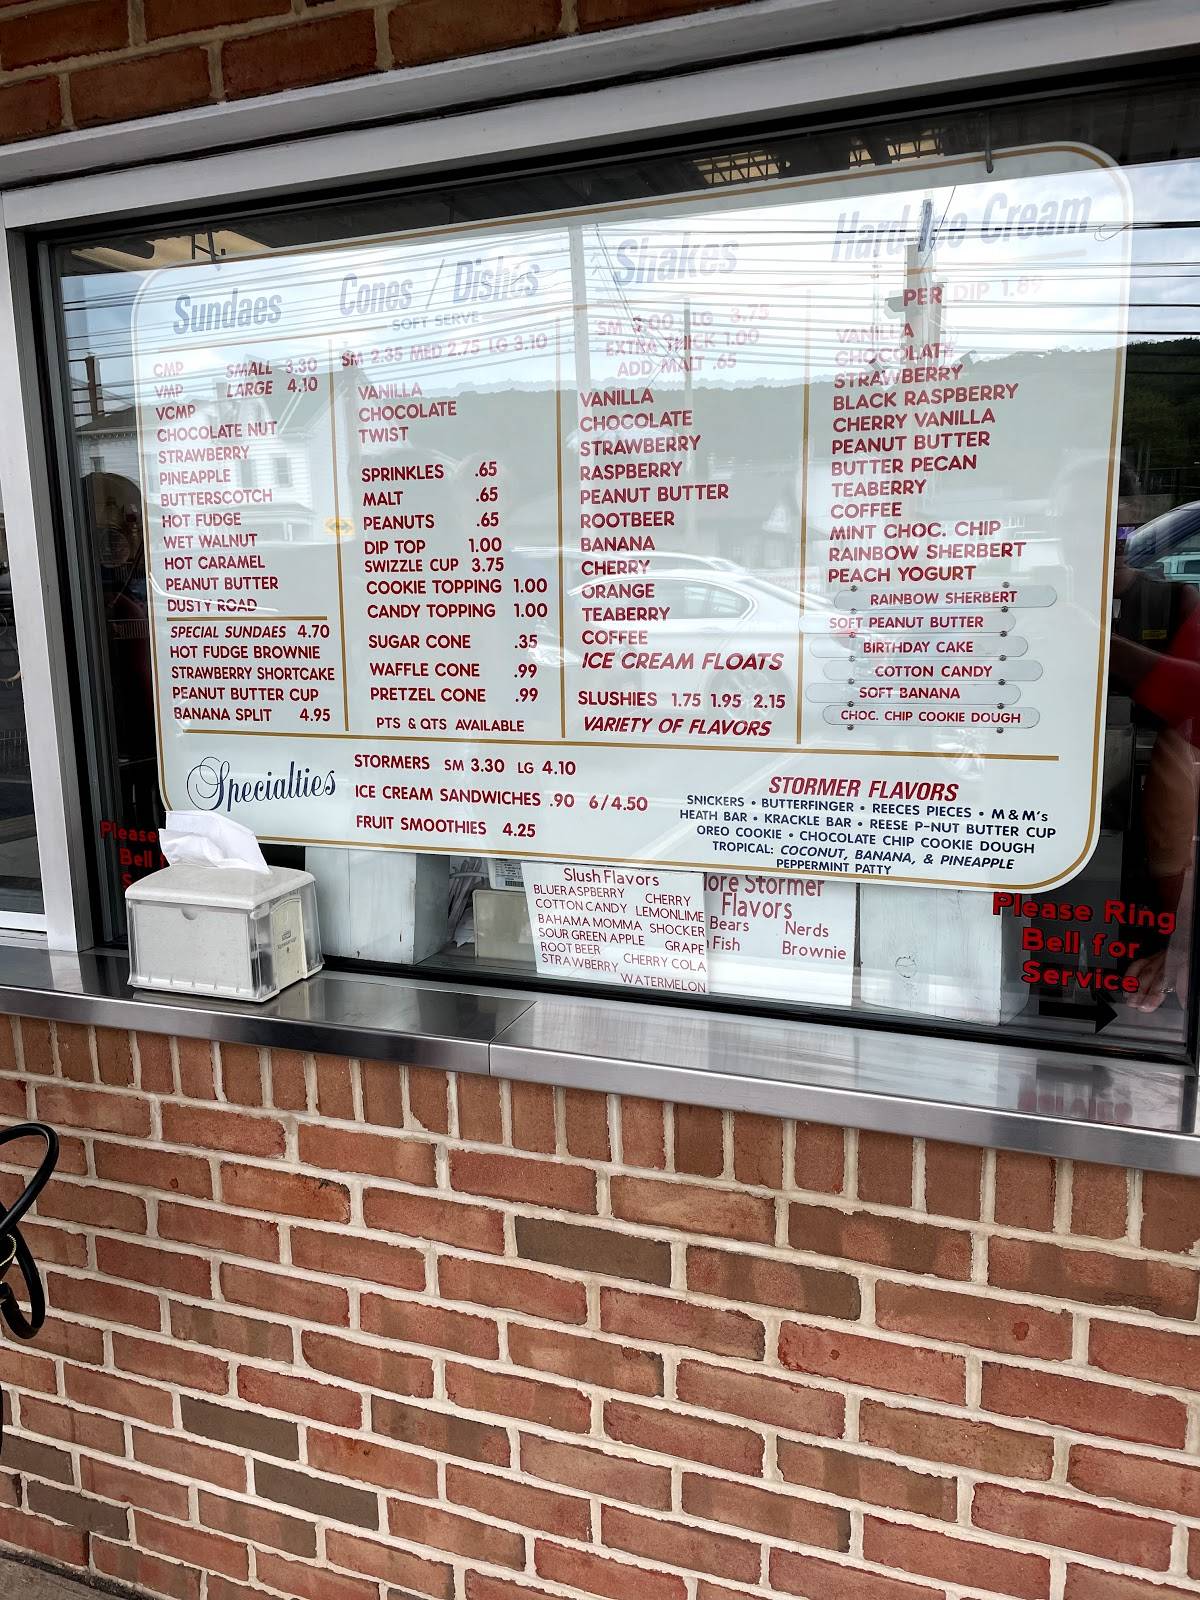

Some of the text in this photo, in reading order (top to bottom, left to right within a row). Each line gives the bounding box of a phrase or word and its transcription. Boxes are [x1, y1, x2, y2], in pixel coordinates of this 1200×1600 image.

[832, 193, 1091, 262] Hard Cream
[615, 237, 739, 285] Shakes
[340, 273, 413, 316] Cones
[173, 288, 282, 334] Sundaes
[392, 311, 480, 331] SOFT SERVE
[836, 322, 914, 344] VANILLA
[153, 361, 184, 377] CMP
[834, 364, 963, 389] STRAWBERRY
[227, 377, 318, 397] LARGE 4.10
[358, 382, 422, 399] VANILLA
[580, 388, 654, 407] VANILLA
[156, 405, 196, 420] VCMP
[833, 408, 995, 432] CHERRY VANILLA
[358, 426, 408, 443] TWIST
[832, 431, 990, 454] PEANUT BUTTER
[580, 435, 701, 456] STRAWBERRY
[158, 446, 249, 464] STRAWBERRY
[363, 487, 498, 506] MALT .65
[580, 484, 729, 504] PEANUT BUTTER
[832, 479, 927, 497] TEABERRY
[160, 489, 272, 507] BUTTERSCOTCH
[162, 513, 241, 528] HOT FUDGE
[363, 512, 499, 530] PEANUTS .65
[580, 511, 674, 529] ROOTBEER
[164, 533, 257, 548] WET WALNUT
[828, 542, 1026, 562] RAINBOW SHERBERT
[364, 557, 504, 572] SWIZZLE CUP 3.75
[581, 560, 650, 575] CHERRY
[166, 576, 279, 591] PEANUT BUTTER
[870, 591, 1017, 605] RAINBOW SHERBERT
[829, 616, 983, 629] SOFT PEANUT BUTTER
[368, 635, 537, 648] SUGAR CONE .35
[582, 630, 648, 645] COFFEE
[170, 646, 320, 659] HOT FUDGE BROWNIE
[172, 687, 319, 701] PEANUT BUTTER CUP
[370, 687, 538, 702] PRETZEL CONE .99
[578, 691, 786, 708] SLUSHIES 1.75 1.95 2.15
[859, 687, 960, 699] SOFT BANANA
[376, 718, 524, 732] PTS & QTS AVAILABLE
[841, 710, 1021, 723] CHOC. CHIP COOKIE DOUGH
[187, 756, 336, 812] Specialties
[769, 776, 959, 802] STORMER FLAVORS
[355, 785, 575, 808] ICE CREAM SANDWICHES .90
[687, 795, 745, 807] SNICKERS
[761, 798, 854, 813] BUTTERFINGER
[872, 803, 920, 815] REECES
[927, 806, 972, 818] PIECES
[100, 820, 157, 842] Please
[356, 815, 536, 837] FRUIT SMOOTHIES 4.25
[680, 809, 1056, 839] HEATH BAR KRACKLE BAR REESE P-NUT BUTTER CUP
[696, 825, 1035, 854] OREO COOKIE CHOCOLATE CHIP COOKIE DOUGH
[120, 848, 152, 868] Bell
[712, 841, 1015, 870] TROPICAL: COCONUT, BANANA, & PINEAPPLE
[776, 859, 892, 875] PEPPERMINT PATTY
[563, 868, 659, 887] Slush Flavors
[535, 899, 627, 913] COTTON CANDY
[645, 894, 691, 905] CHERRY
[722, 893, 792, 919] Flavors
[538, 913, 642, 930] BAHAMA MOMMA
[635, 906, 704, 923] LEMONLIME
[992, 892, 1176, 935] Please Ring
[649, 923, 705, 936] SHOCKER
[710, 916, 749, 931] Bears
[785, 921, 829, 937] Nerds
[539, 928, 645, 946] SOUR GREEN APPLE
[713, 936, 740, 951] Fish
[1022, 927, 1140, 959] Bell for
[540, 941, 600, 955] ROOT BEER
[665, 941, 704, 955] GRAPE
[782, 941, 846, 959] Brownie
[541, 954, 618, 972] STRAWBERRY
[623, 953, 706, 972] CHERRY COLA
[621, 972, 705, 993] WATERMELON
[1022, 960, 1139, 993] Service
